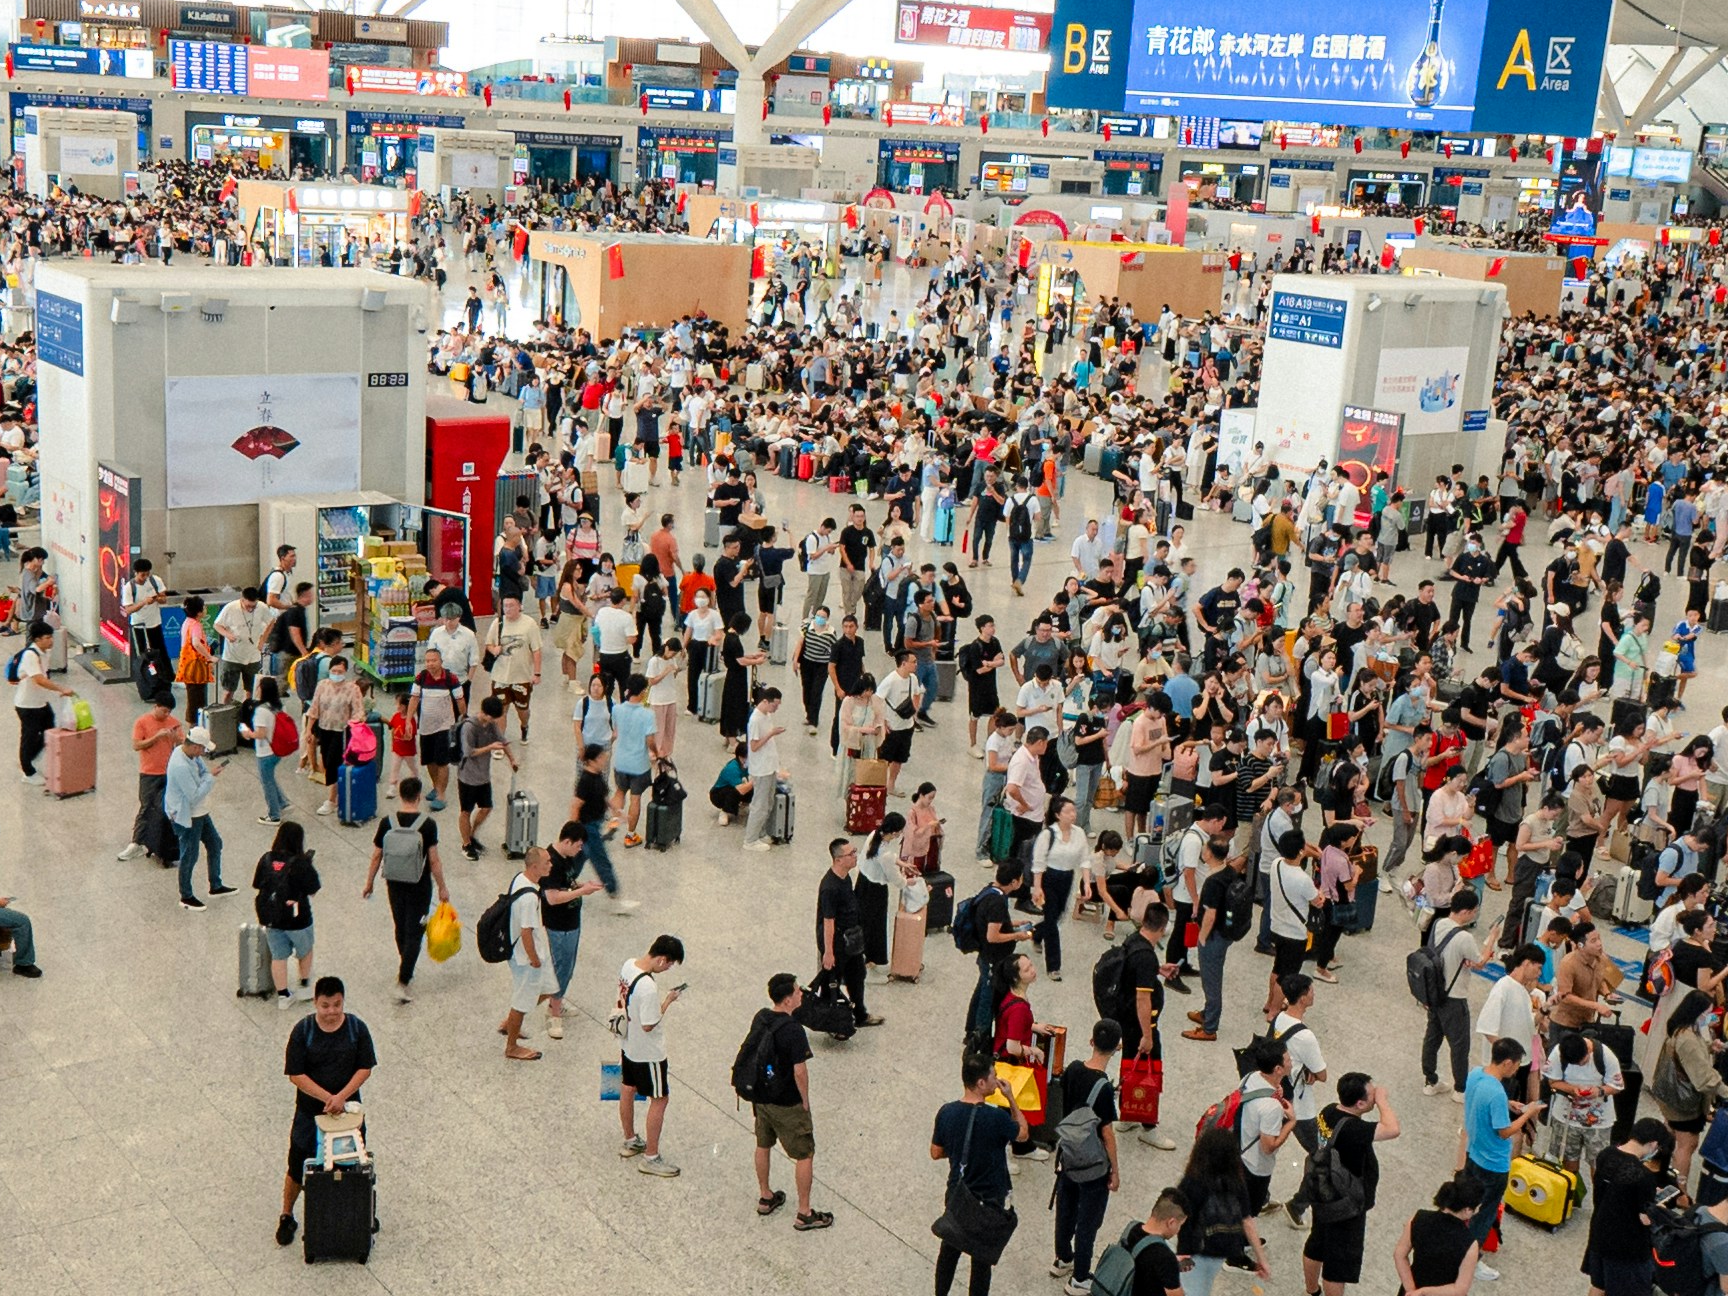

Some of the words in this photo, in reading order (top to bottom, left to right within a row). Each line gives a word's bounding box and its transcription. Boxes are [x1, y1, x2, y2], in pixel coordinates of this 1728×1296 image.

[1146, 24, 1215, 57] 青花郎
[1218, 32, 1305, 58] 赤水河左岸
[1310, 34, 1387, 61] 庄园酱酒
[1089, 62, 1109, 75] Area
[1539, 74, 1570, 93] Area
[1299, 315, 1312, 327] A1
